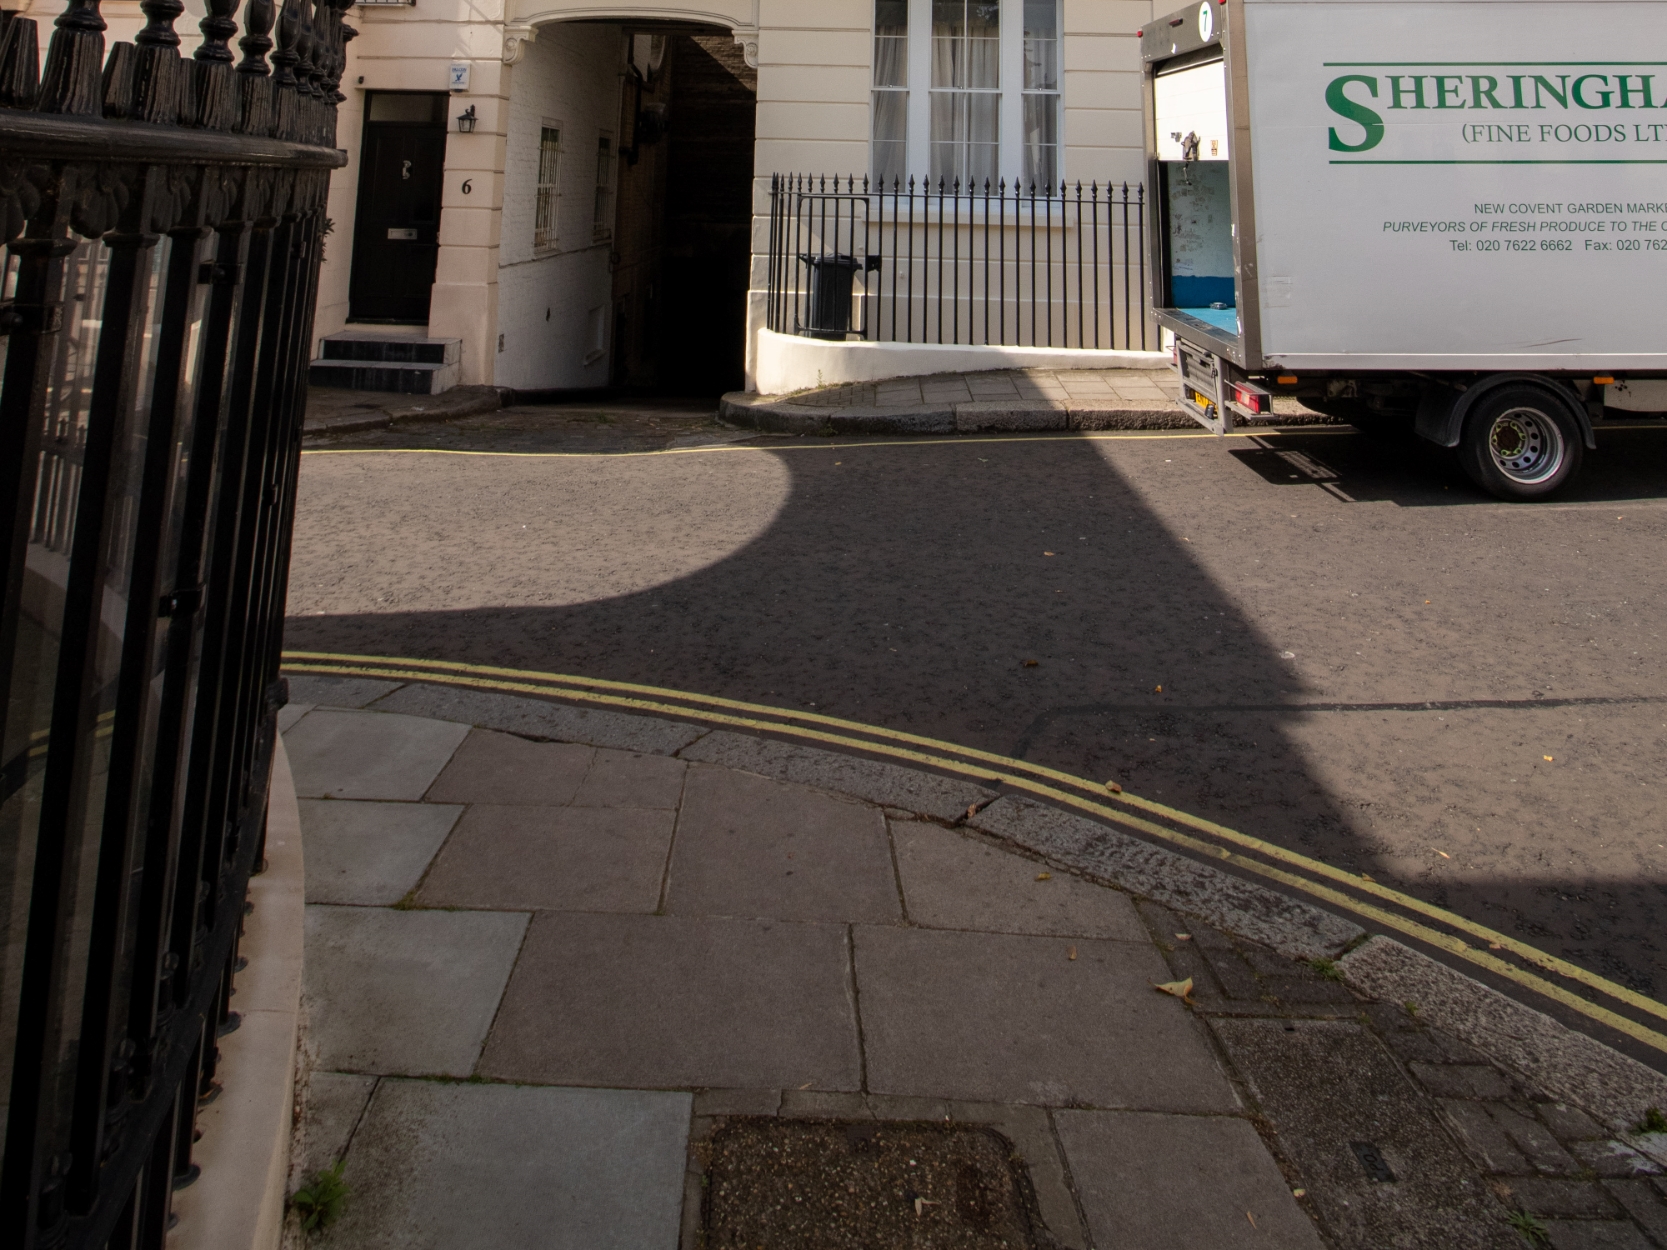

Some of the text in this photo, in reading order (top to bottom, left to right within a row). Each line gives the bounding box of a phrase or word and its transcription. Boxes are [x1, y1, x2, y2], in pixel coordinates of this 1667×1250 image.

[1202, 10, 1208, 32] 7
[1325, 74, 1667, 153] SHERINGH
[1462, 123, 1667, 144] (FINE FOODS LT
[461, 178, 473, 195] 6
[1474, 203, 1505, 214] NEW
[1508, 203, 1563, 214] COVENT
[1567, 203, 1622, 214] GARDEN
[1382, 221, 1466, 232] PURVEYORS
[1469, 221, 1488, 232] OF
[1491, 221, 1536, 232] FRESH
[1540, 221, 1606, 232] PRODUCE
[1610, 221, 1627, 232] TO
[1631, 221, 1657, 232] THE
[1449, 239, 1472, 251] Tel:
[1476, 239, 1501, 251] 020
[1504, 239, 1537, 251] 7622
[1540, 239, 1573, 251] 6662
[1584, 239, 1612, 251] Fax:
[1616, 239, 1641, 251] 020
